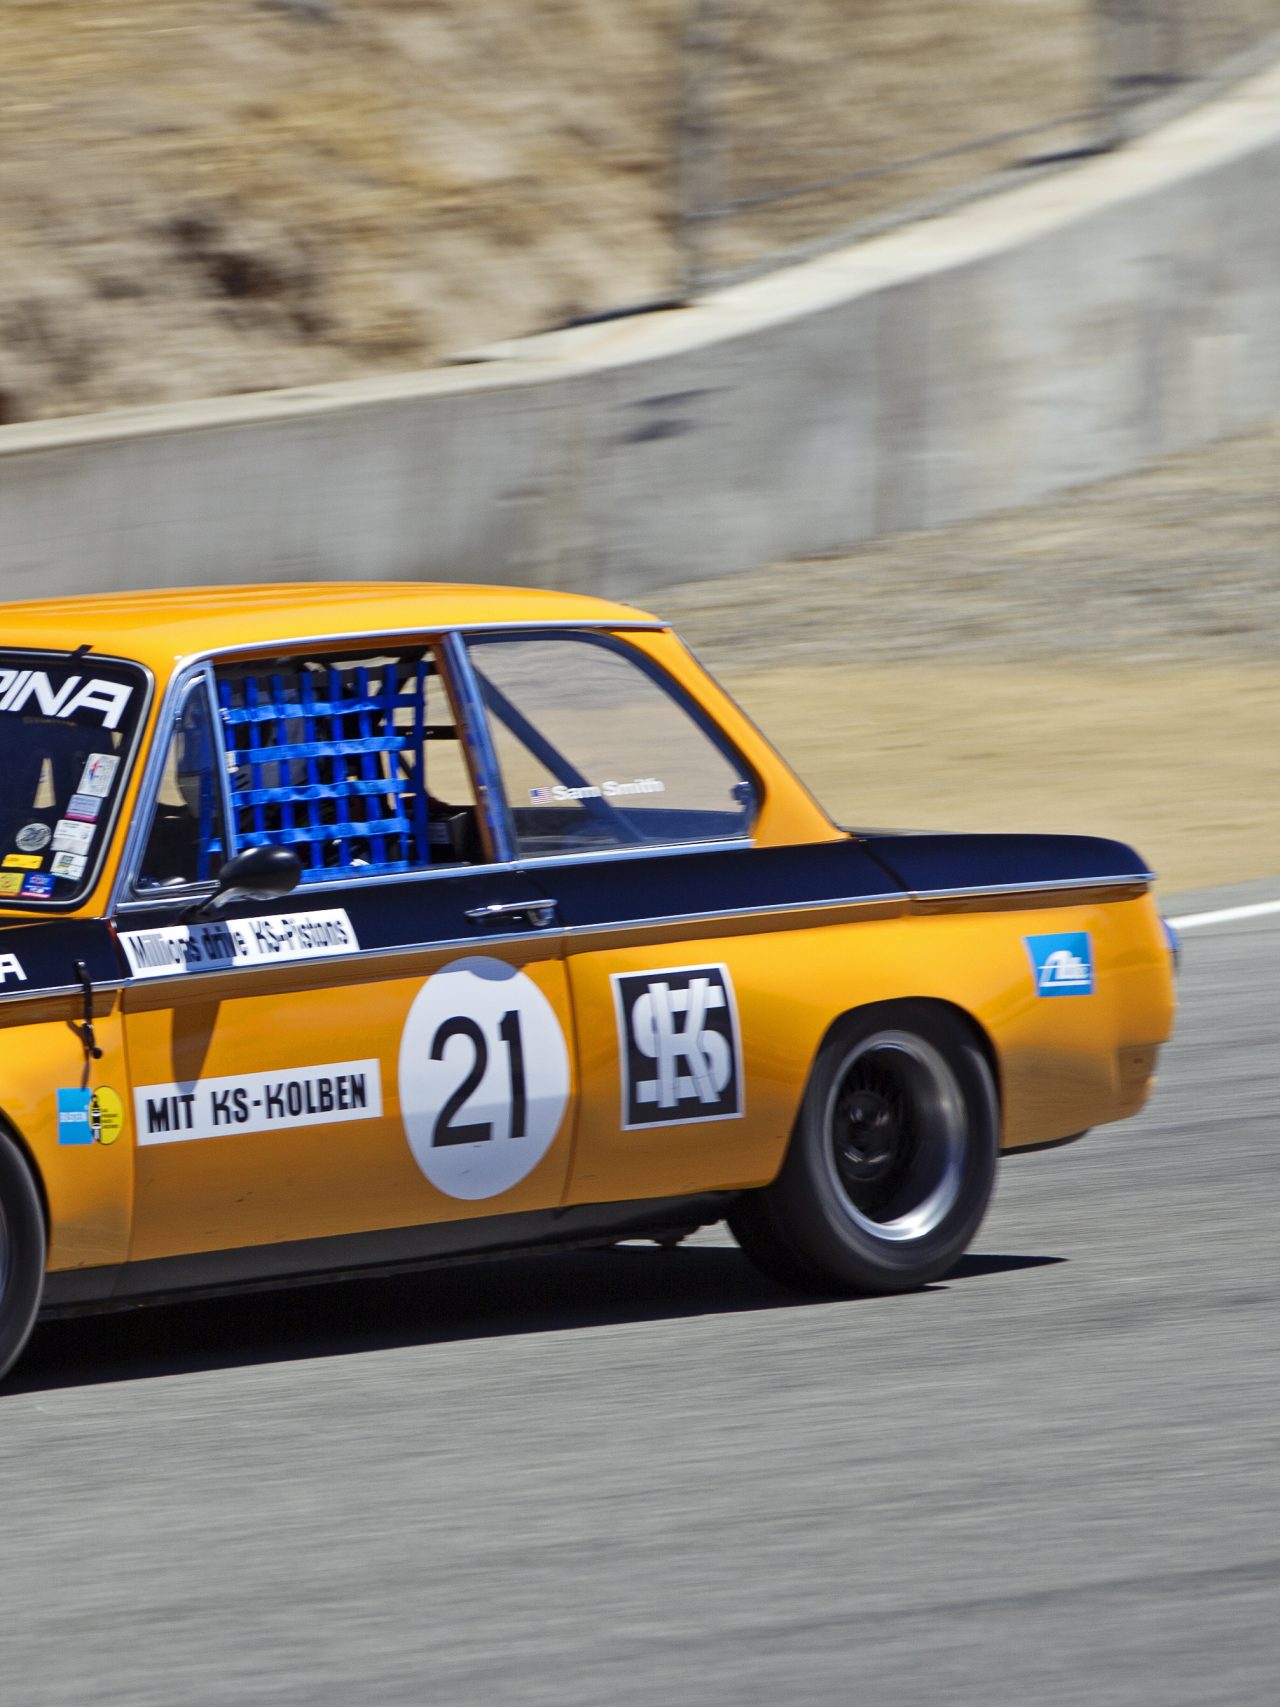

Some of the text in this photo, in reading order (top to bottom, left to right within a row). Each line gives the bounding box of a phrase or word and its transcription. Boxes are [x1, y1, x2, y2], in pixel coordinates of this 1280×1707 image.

[552, 784, 601, 801] Sam
[147, 1093, 196, 1133] MIT
[211, 1073, 367, 1126] KS-KOLBEN
[430, 1009, 527, 1148] 21
